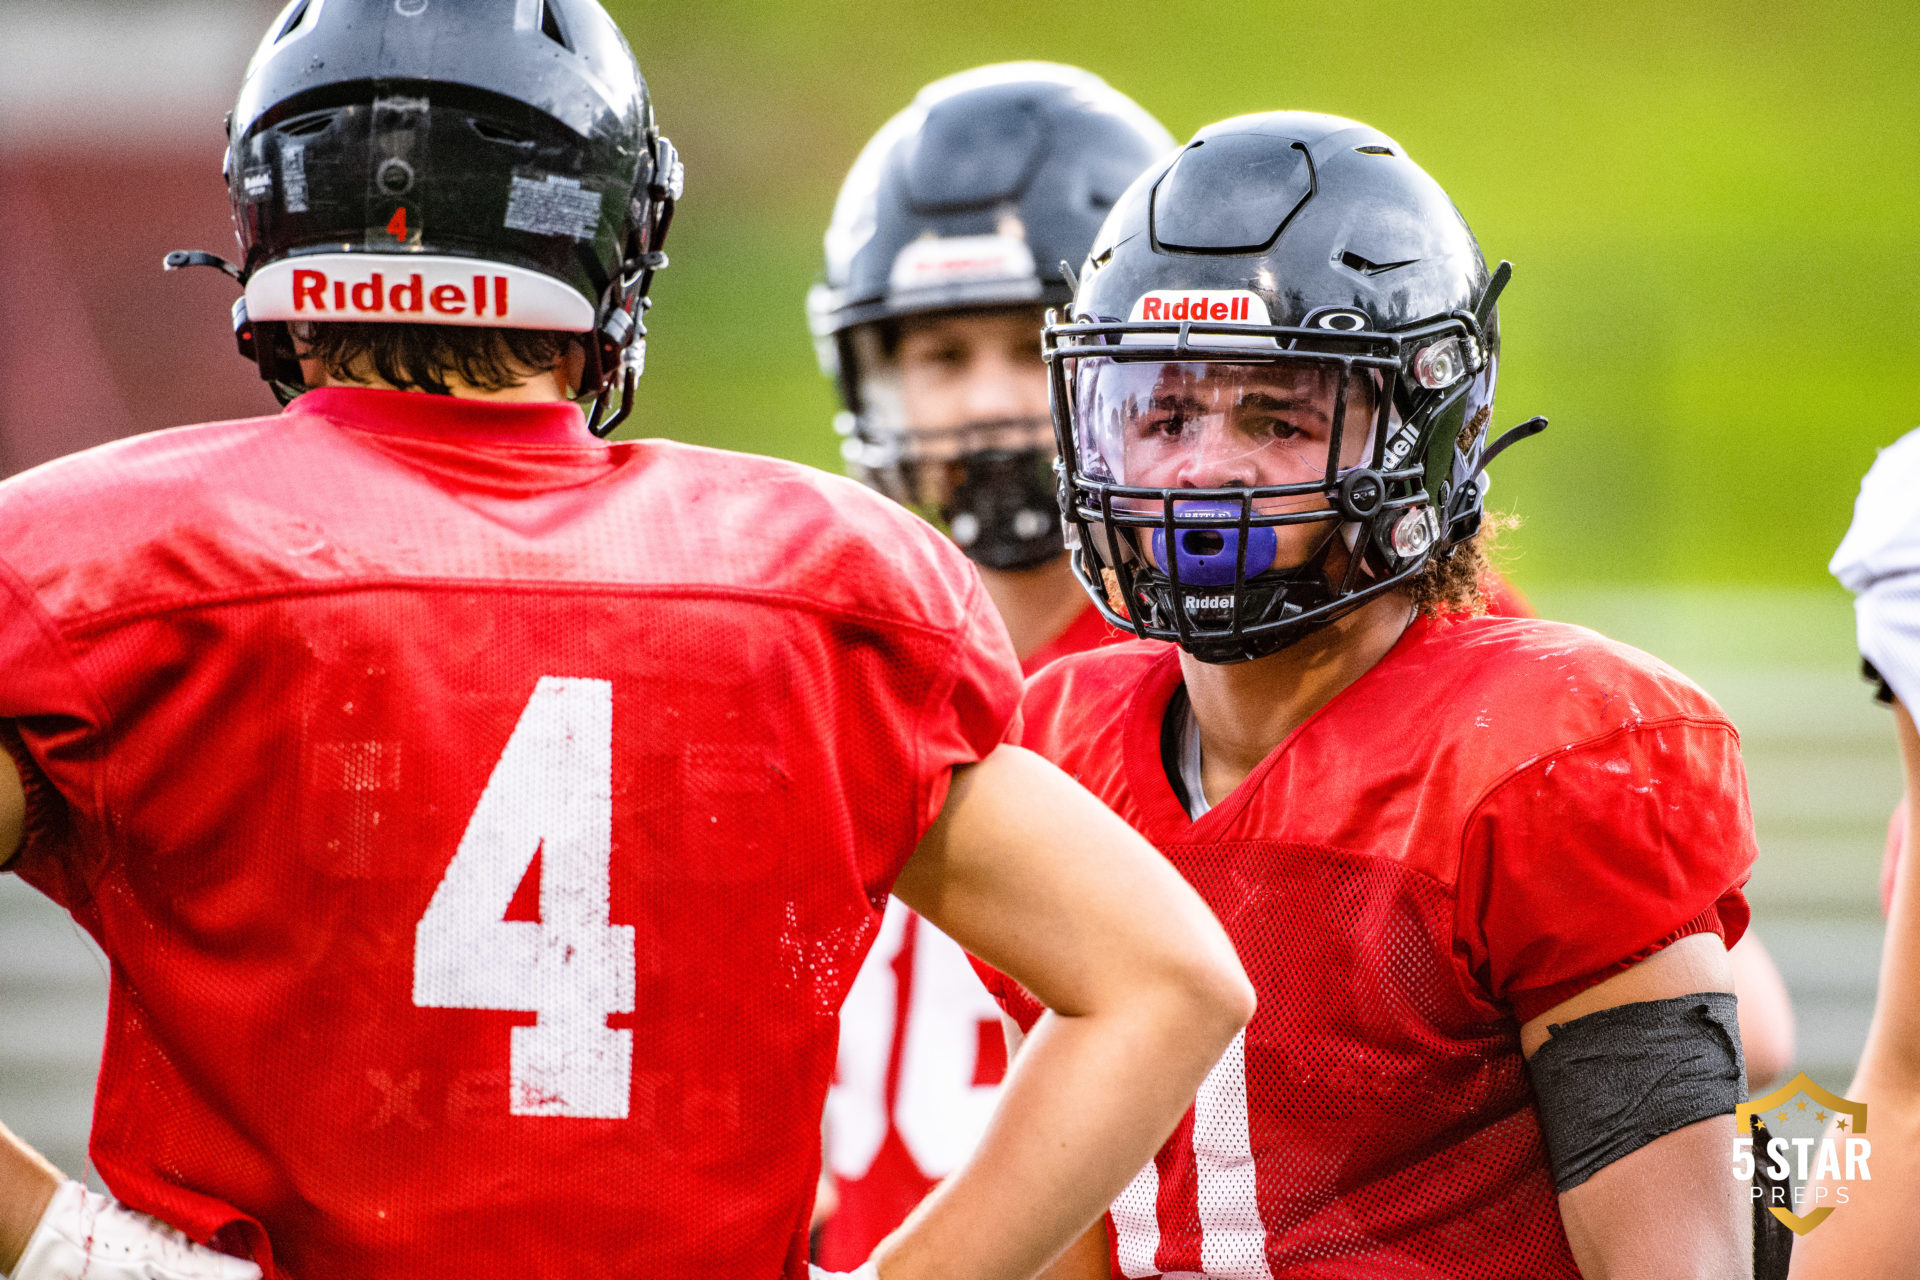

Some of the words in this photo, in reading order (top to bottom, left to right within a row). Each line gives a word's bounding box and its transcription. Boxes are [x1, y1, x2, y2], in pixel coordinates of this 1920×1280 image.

[387, 207, 407, 242] 4
[293, 269, 508, 317] Riddell
[1143, 297, 1249, 320] Riddell
[1382, 423, 1420, 472] dell
[1185, 595, 1235, 608] Riddel
[413, 675, 637, 1119] 4
